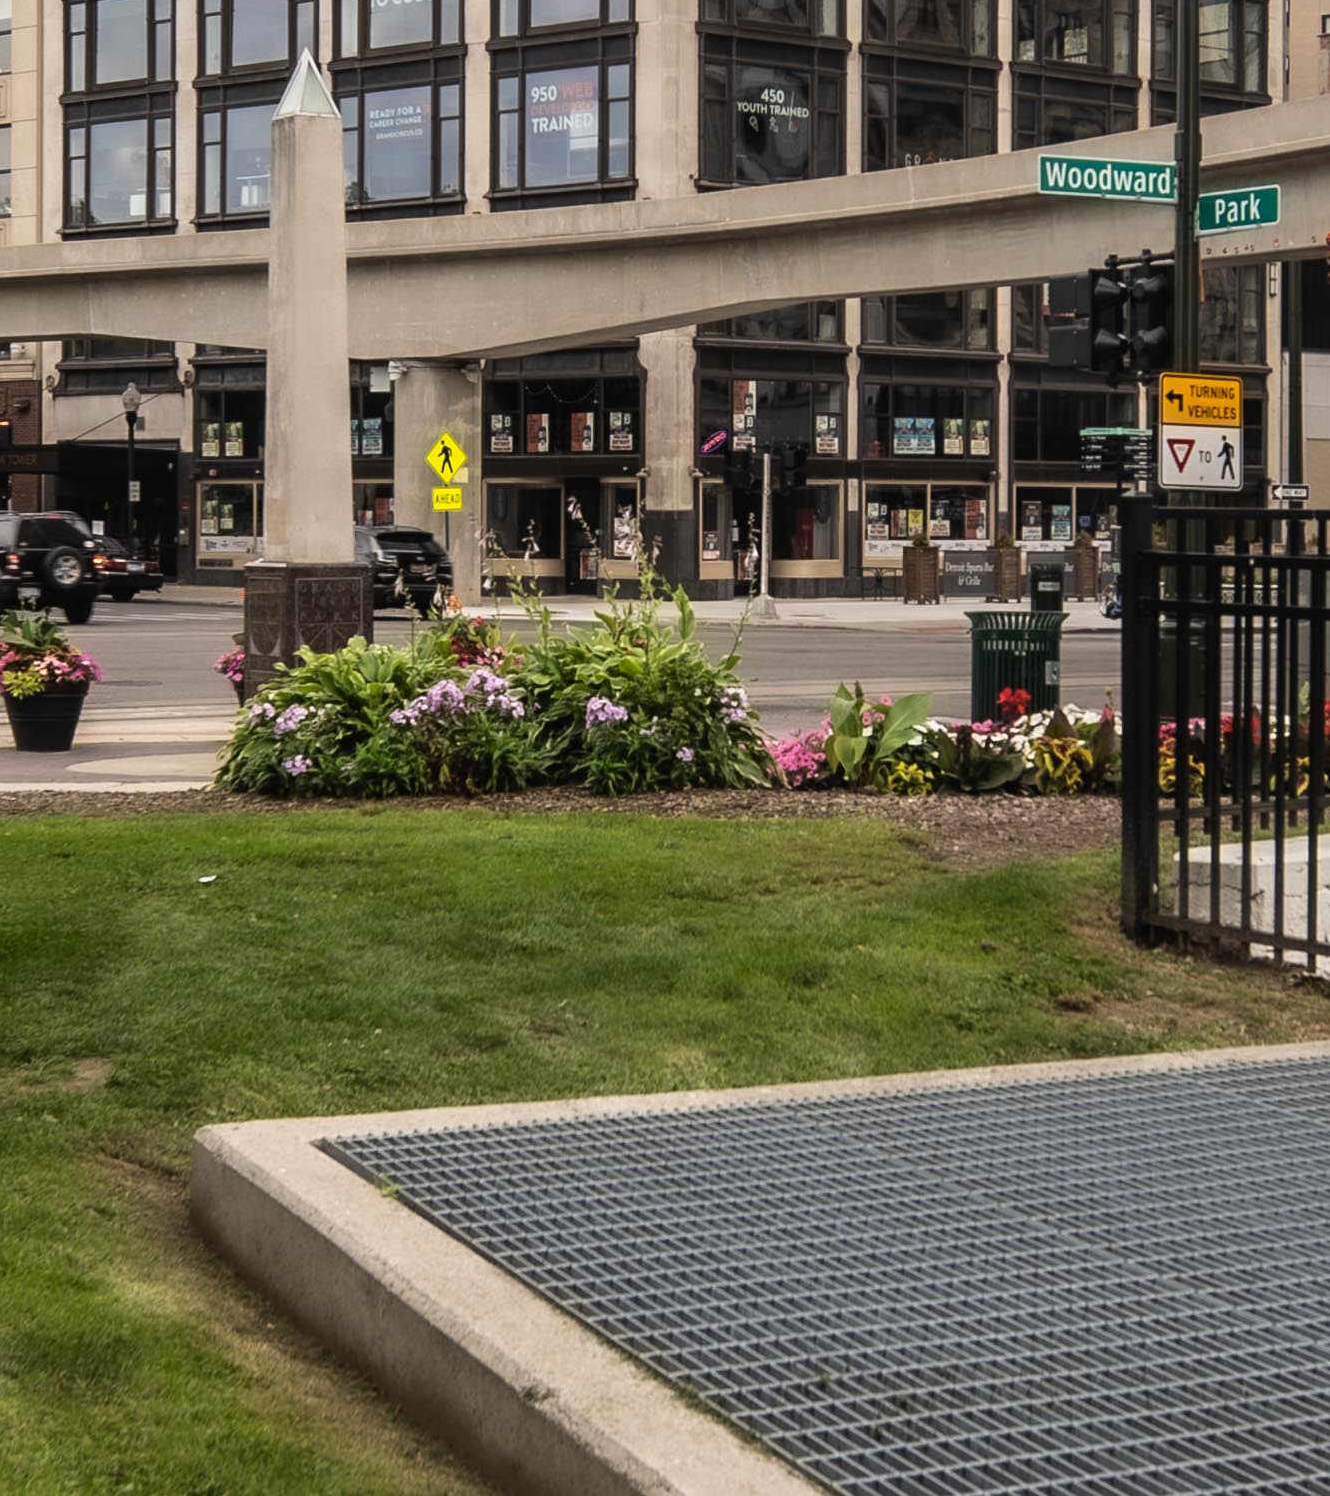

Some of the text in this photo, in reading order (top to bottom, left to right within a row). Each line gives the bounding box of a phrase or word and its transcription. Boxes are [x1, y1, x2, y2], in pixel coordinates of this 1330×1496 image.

[1045, 162, 1171, 194] Woodward
[1215, 193, 1261, 224] Park
[1189, 385, 1235, 400] TURNING
[1188, 405, 1237, 420] VEHICLES
[1199, 450, 1212, 463] TO
[435, 493, 460, 504] AHEAD
